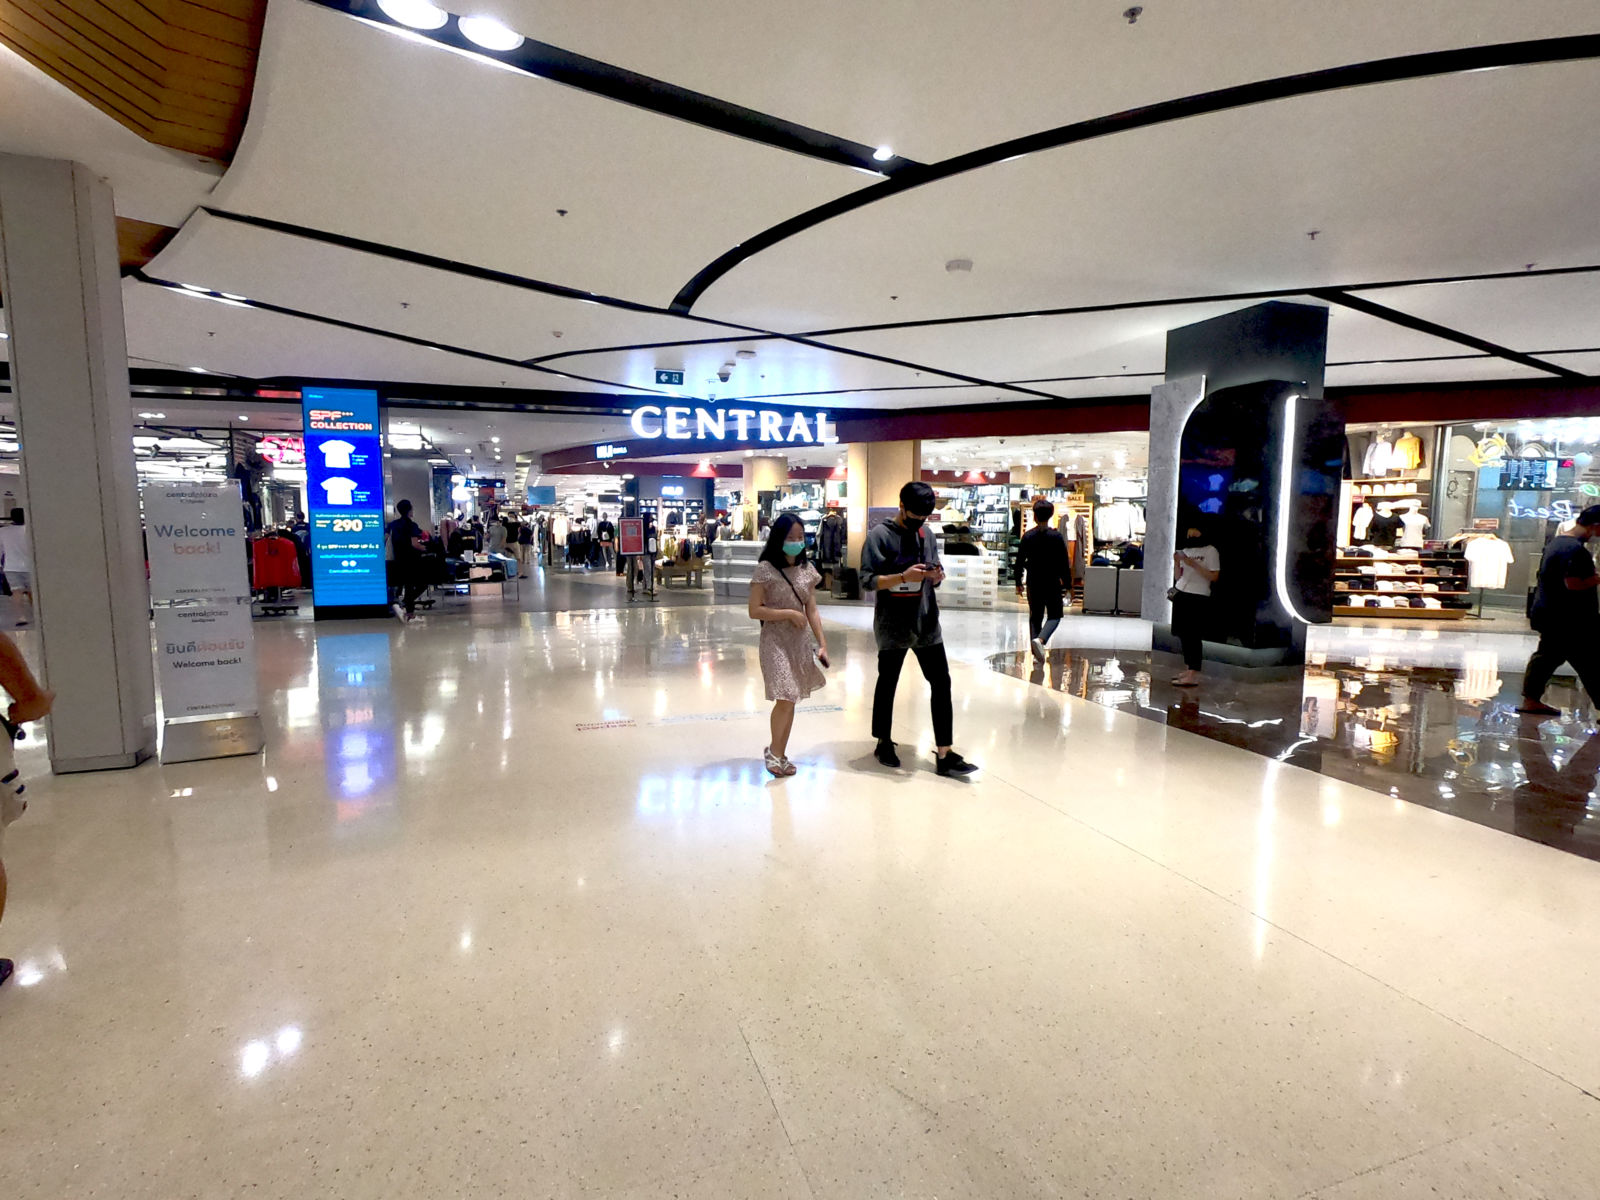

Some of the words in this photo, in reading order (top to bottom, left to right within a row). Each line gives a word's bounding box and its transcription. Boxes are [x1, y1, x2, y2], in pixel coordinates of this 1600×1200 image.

[309, 421, 373, 431] COLLECTION
[630, 404, 840, 444] CENTRAL
[153, 524, 236, 538] Welcome
[332, 518, 363, 532] 290
[173, 541, 221, 556] back!
[172, 659, 215, 669] Welcome
[217, 656, 242, 667] back!
